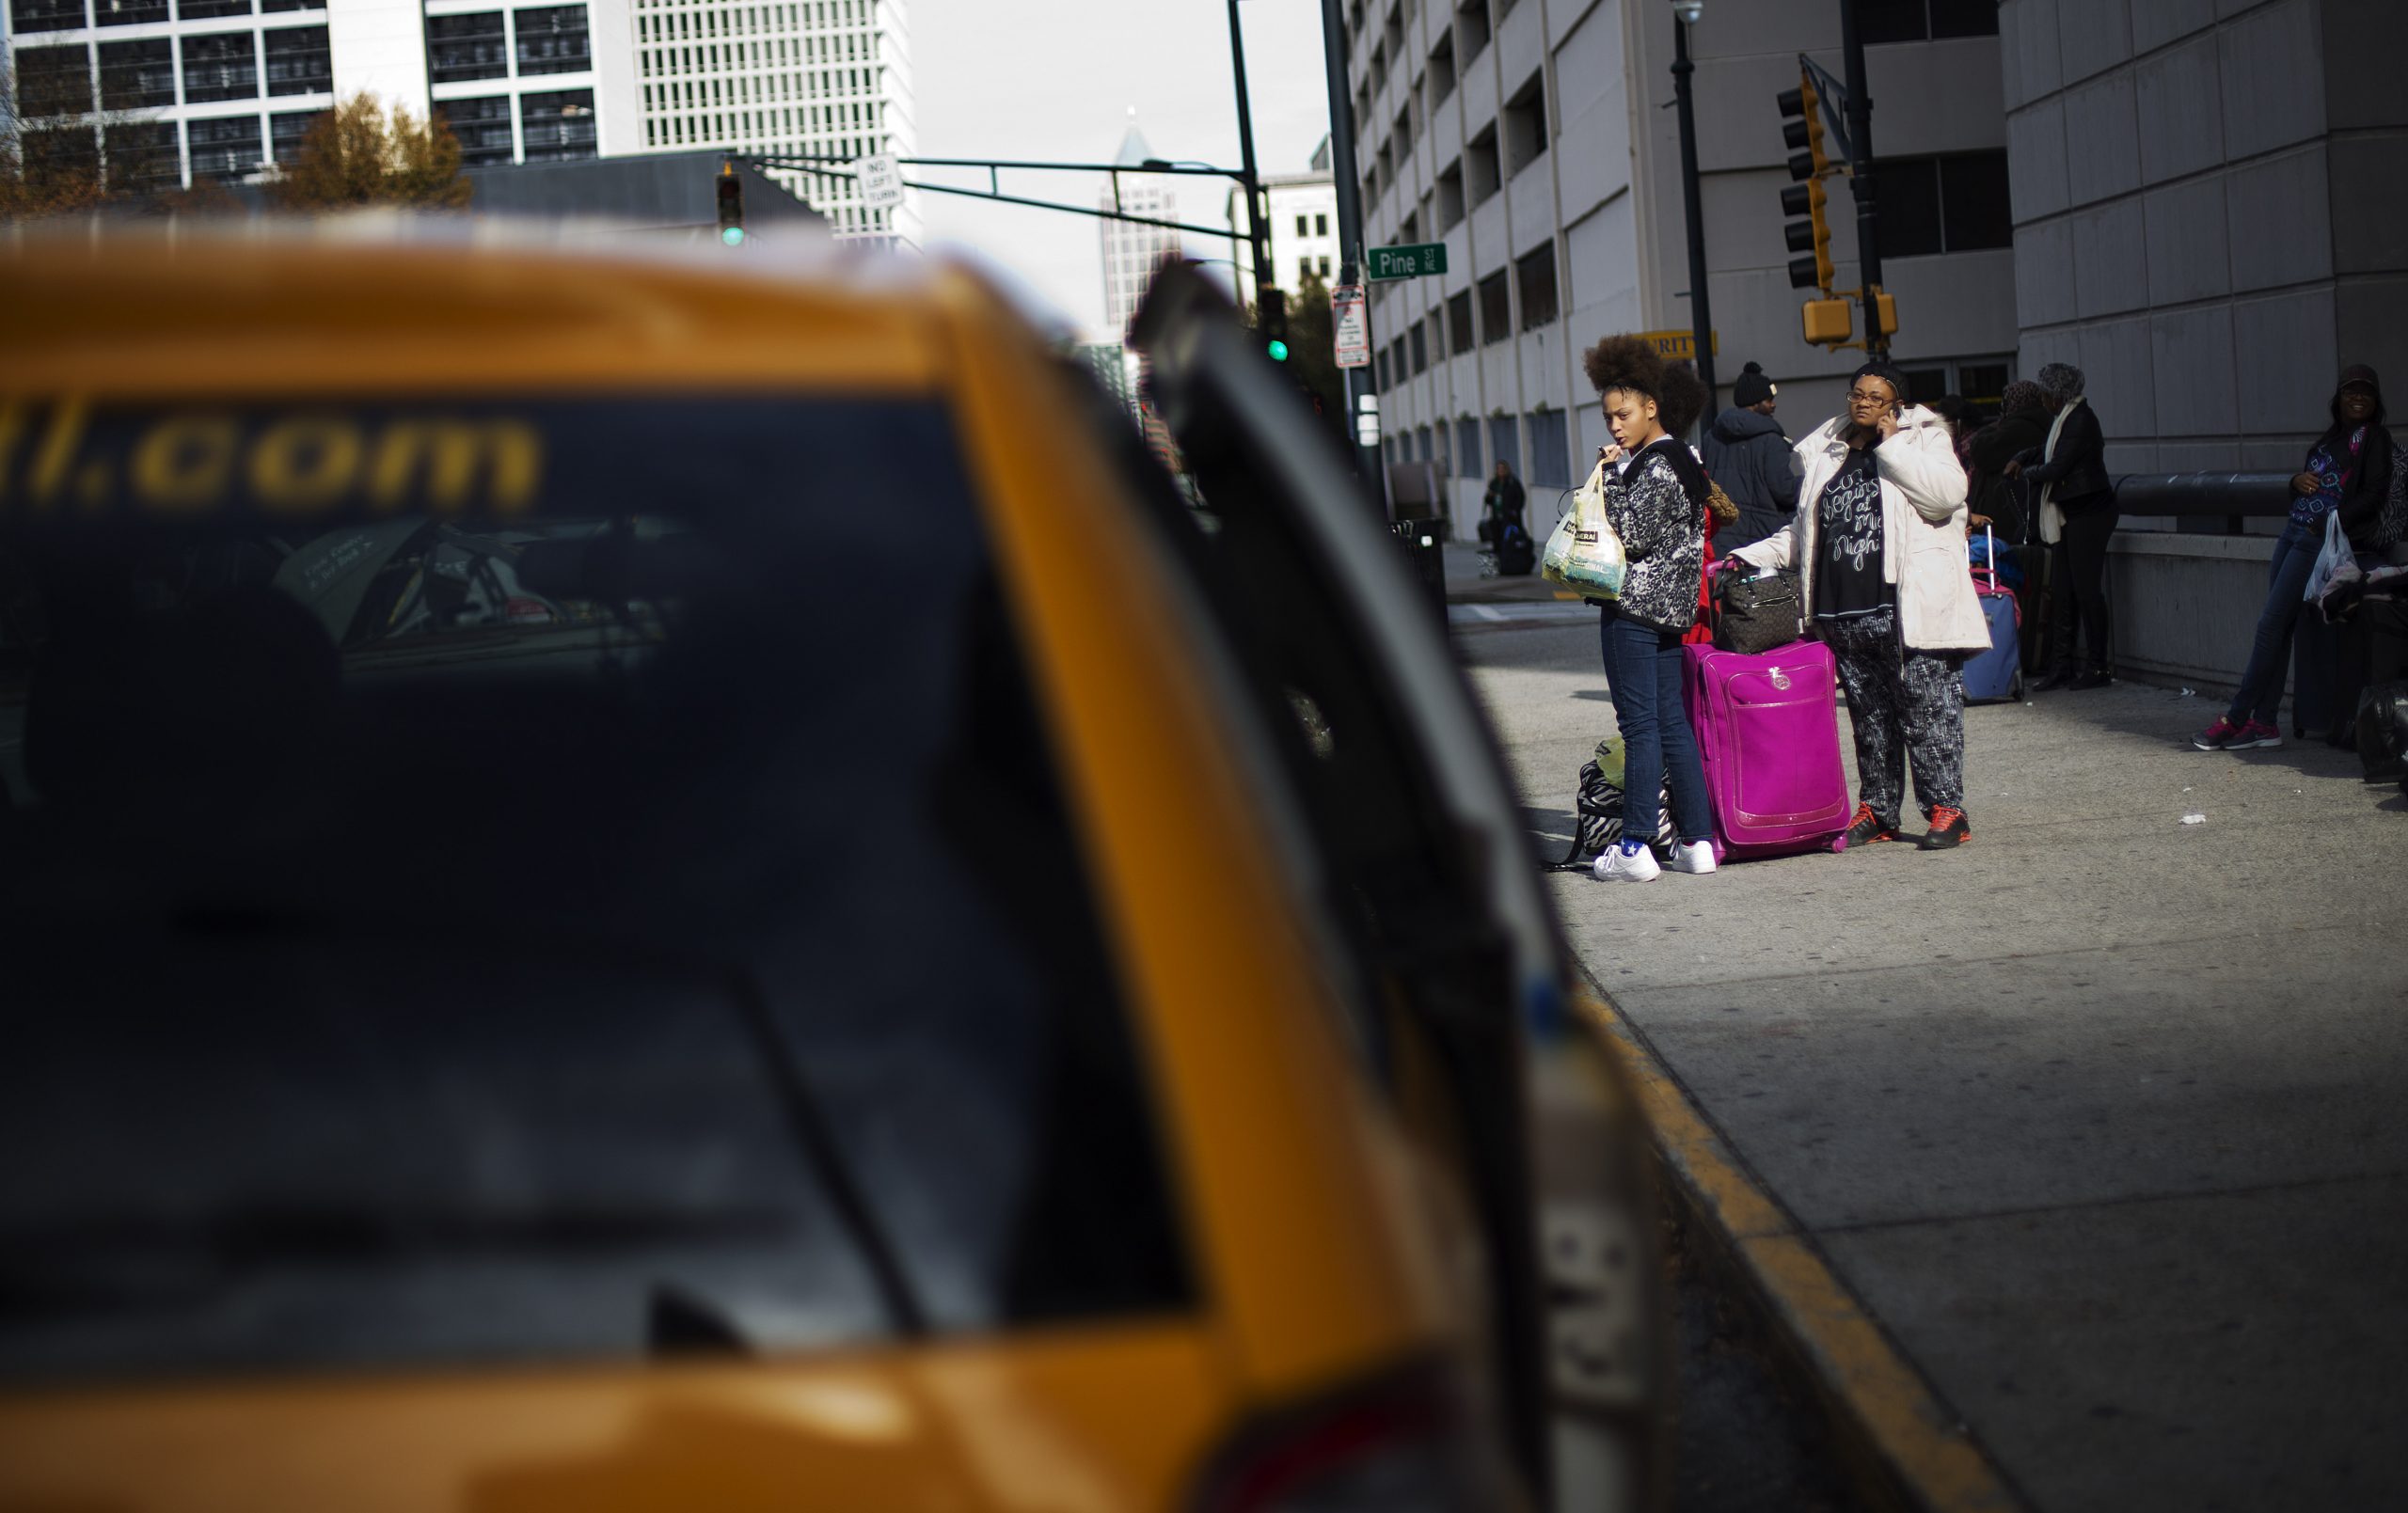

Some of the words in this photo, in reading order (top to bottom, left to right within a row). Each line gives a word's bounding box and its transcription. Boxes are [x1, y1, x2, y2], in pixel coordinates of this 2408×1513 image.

[867, 160, 886, 173] NO
[866, 174, 893, 188] LEFT
[868, 189, 899, 202] TURN
[1379, 252, 1416, 275] Pine
[1423, 248, 1435, 260] ST
[1424, 260, 1436, 272] NE
[1856, 495, 1872, 512] at
